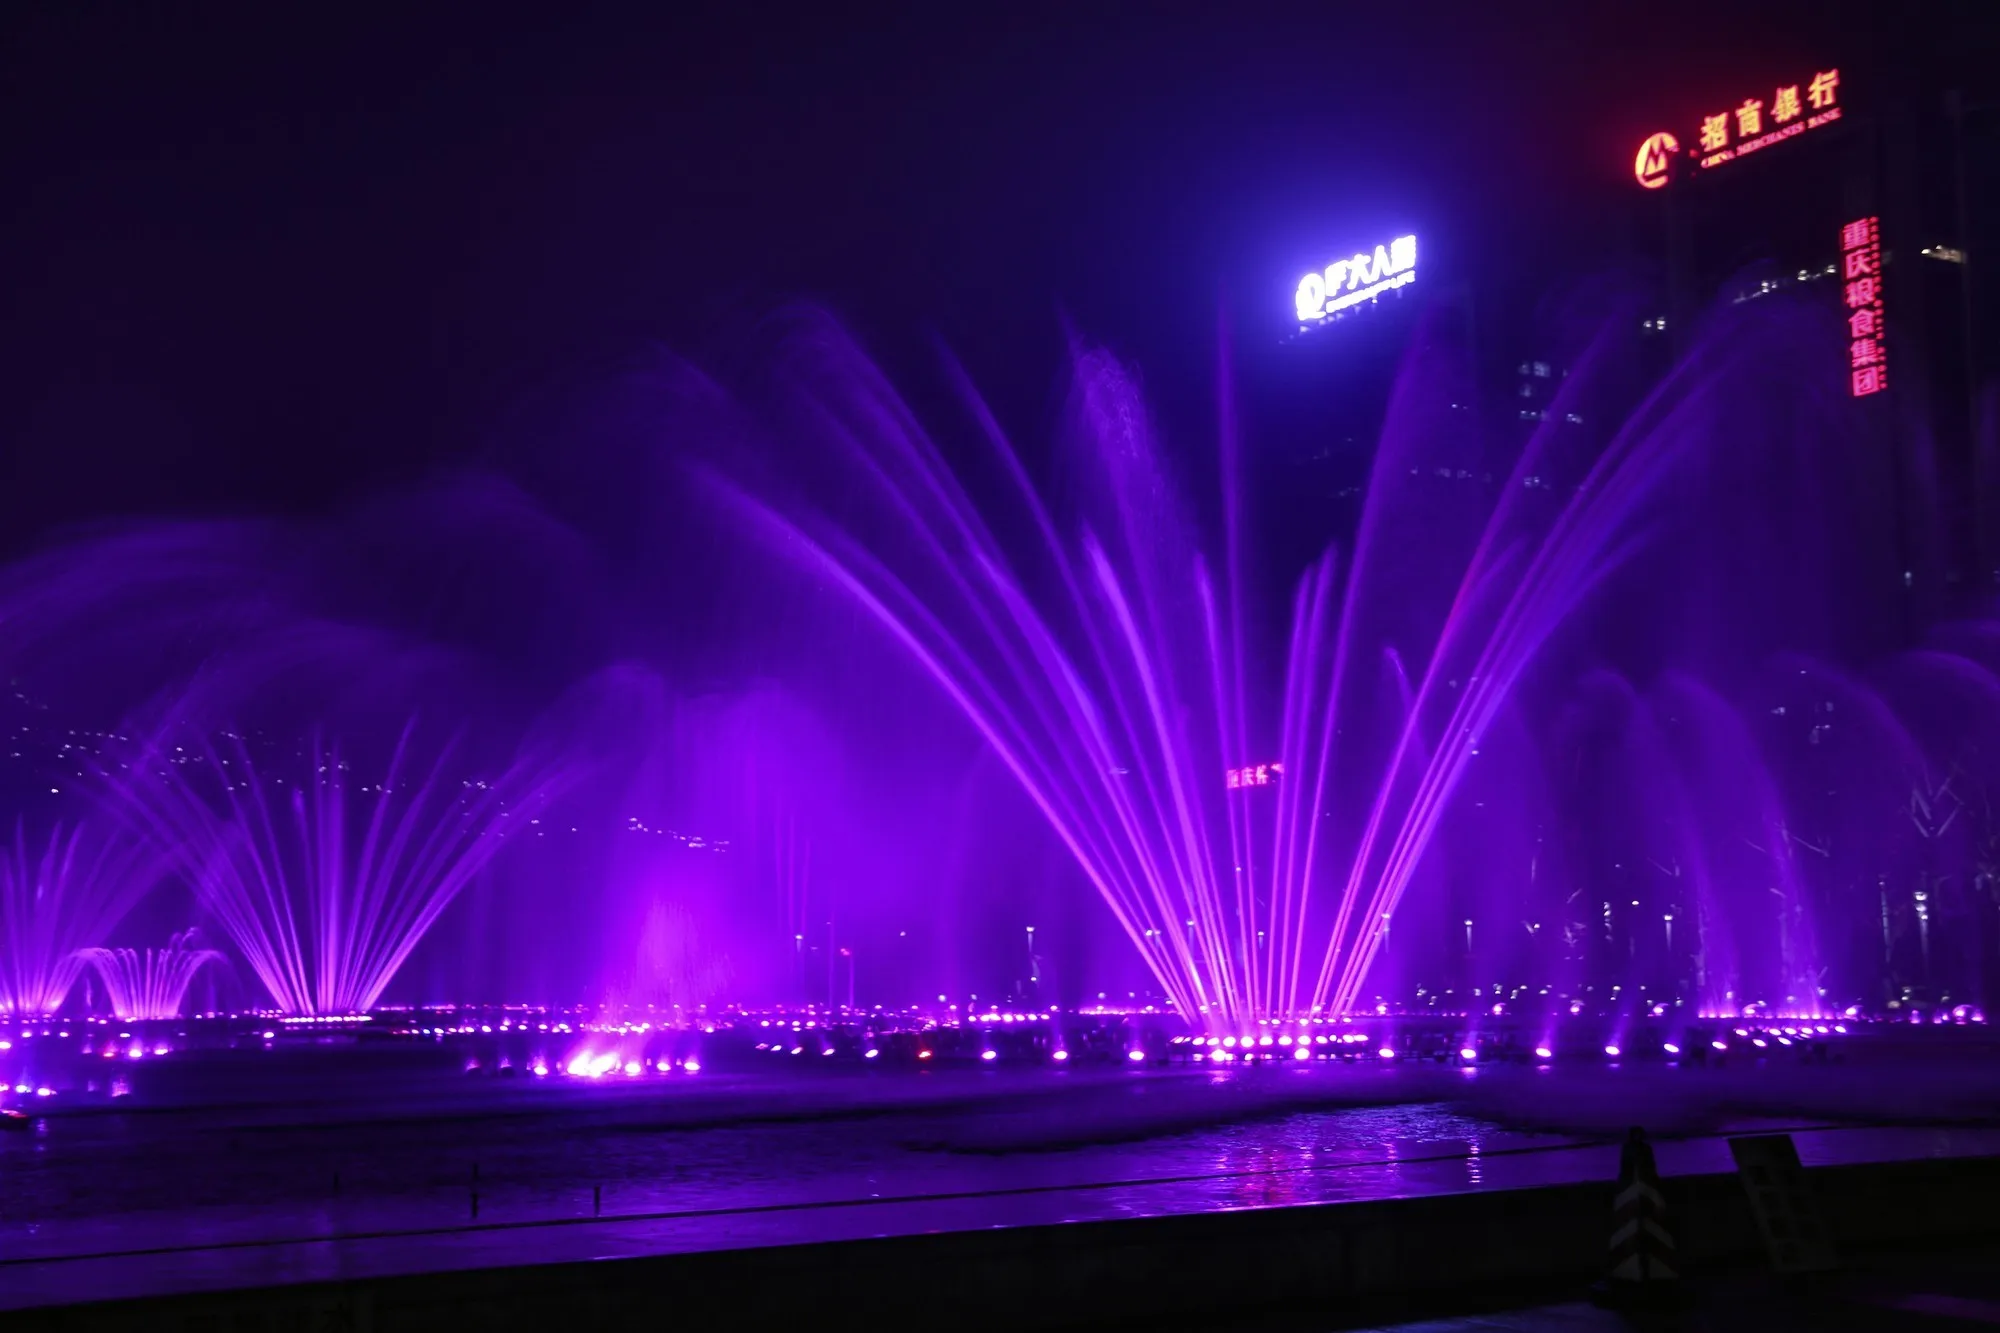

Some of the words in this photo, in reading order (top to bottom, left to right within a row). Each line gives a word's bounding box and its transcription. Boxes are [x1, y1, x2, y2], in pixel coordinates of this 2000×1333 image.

[1700, 69, 1839, 152] 招商银行
[1701, 150, 1735, 168] CHINA
[1808, 107, 1842, 129] BANK
[1843, 218, 1880, 397] 重庆粮食集团
